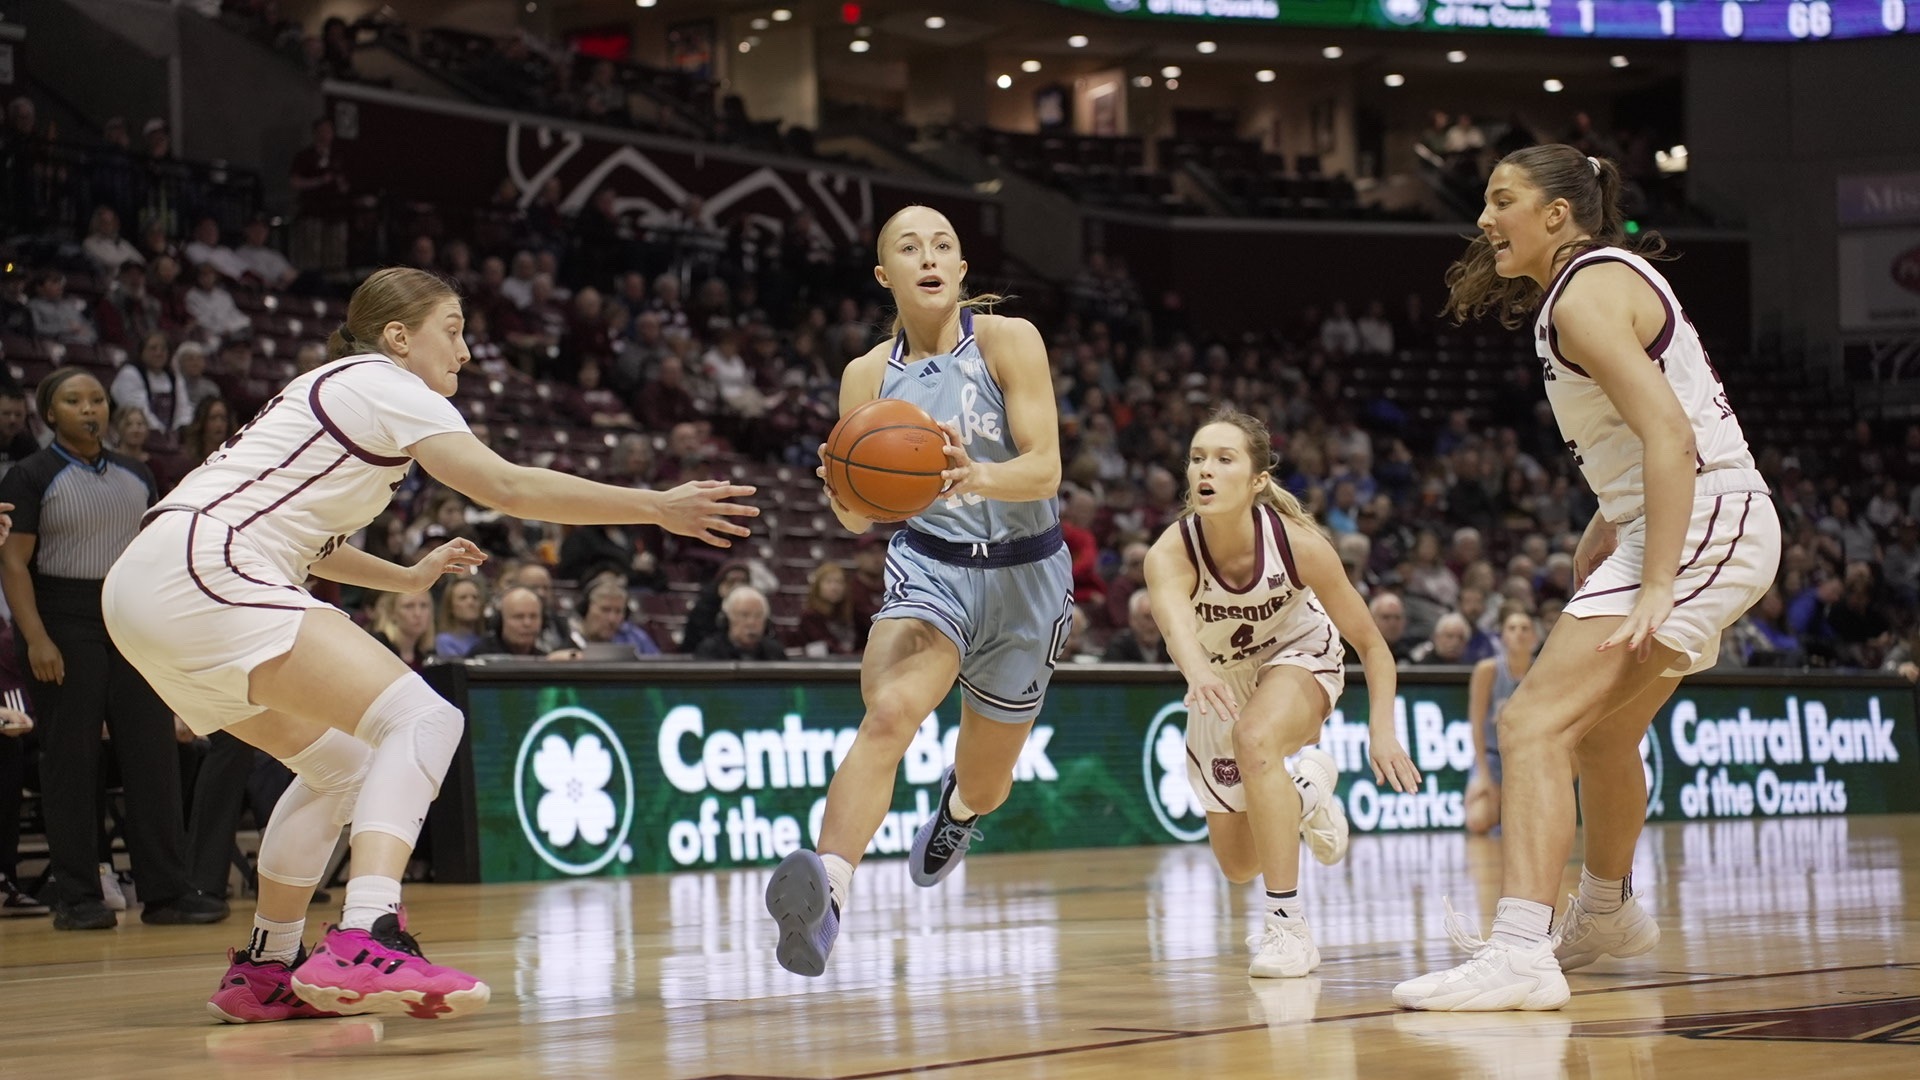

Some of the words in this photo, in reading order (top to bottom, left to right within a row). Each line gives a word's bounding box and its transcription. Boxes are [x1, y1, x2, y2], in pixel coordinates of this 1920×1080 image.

[1489, 5, 1551, 29] Ozark
[1722, 0, 1744, 38] 0
[1788, 0, 1832, 38] 66
[1230, 623, 1254, 649] 4
[658, 705, 860, 793] Centr
[1413, 701, 1475, 771] Ba
[1671, 695, 1803, 766] Central
[1804, 696, 1900, 764] Bank
[1349, 774, 1466, 831] Ozarks
[1680, 767, 1709, 818] of
[1711, 766, 1754, 817] the
[1756, 766, 1848, 815] Ozarks
[668, 797, 721, 865] of
[726, 796, 801, 861] the
